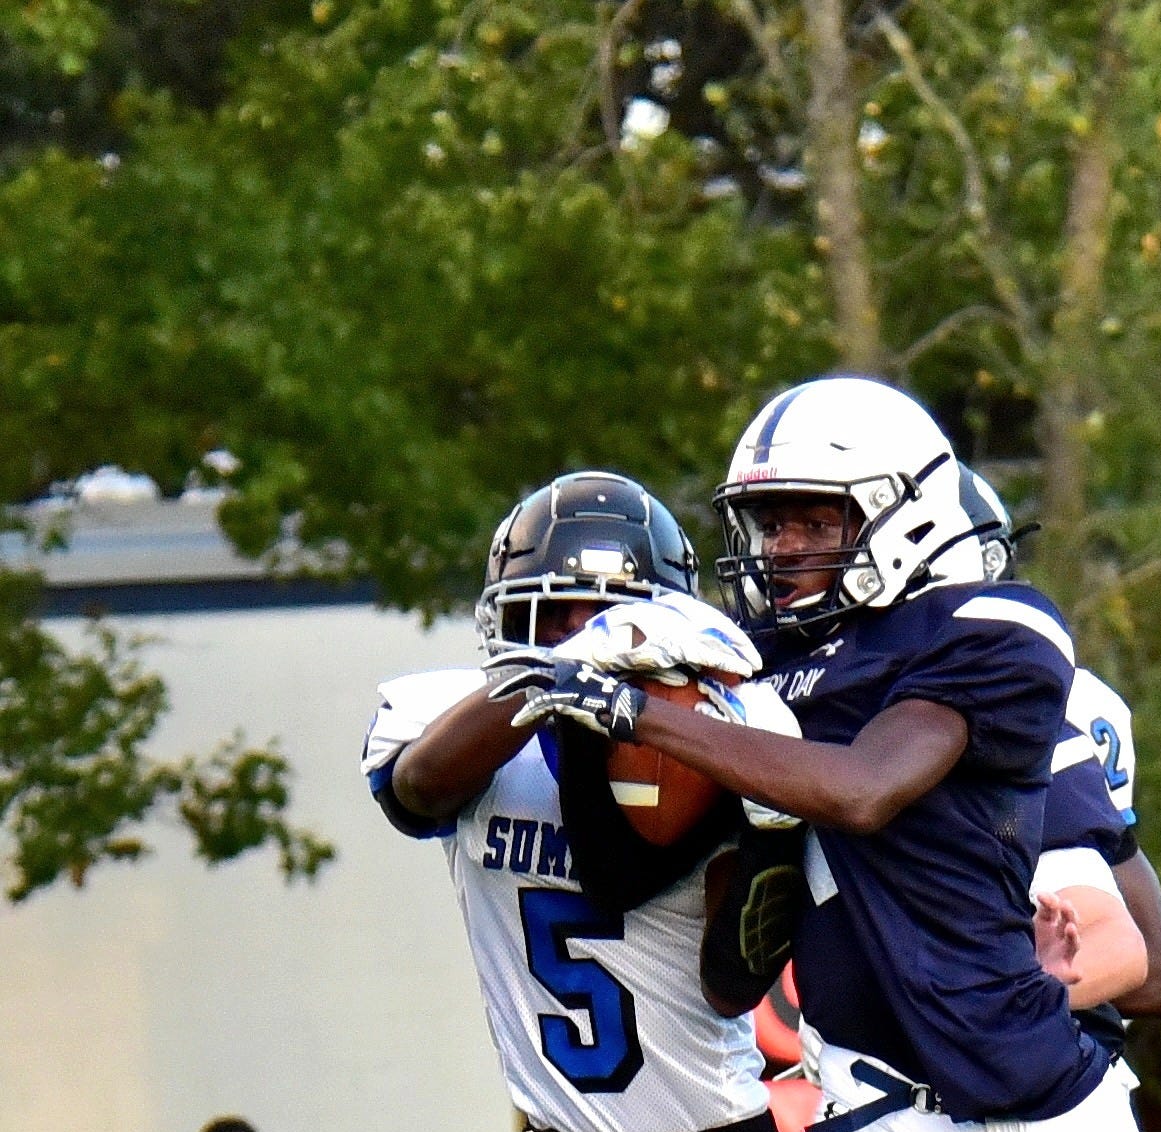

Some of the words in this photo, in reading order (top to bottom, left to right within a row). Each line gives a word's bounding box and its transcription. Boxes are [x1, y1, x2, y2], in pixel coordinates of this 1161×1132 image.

[787, 668, 826, 700] DAY
[1090, 716, 1129, 792] 2
[484, 815, 580, 880] SUM
[518, 887, 645, 1094] 5
